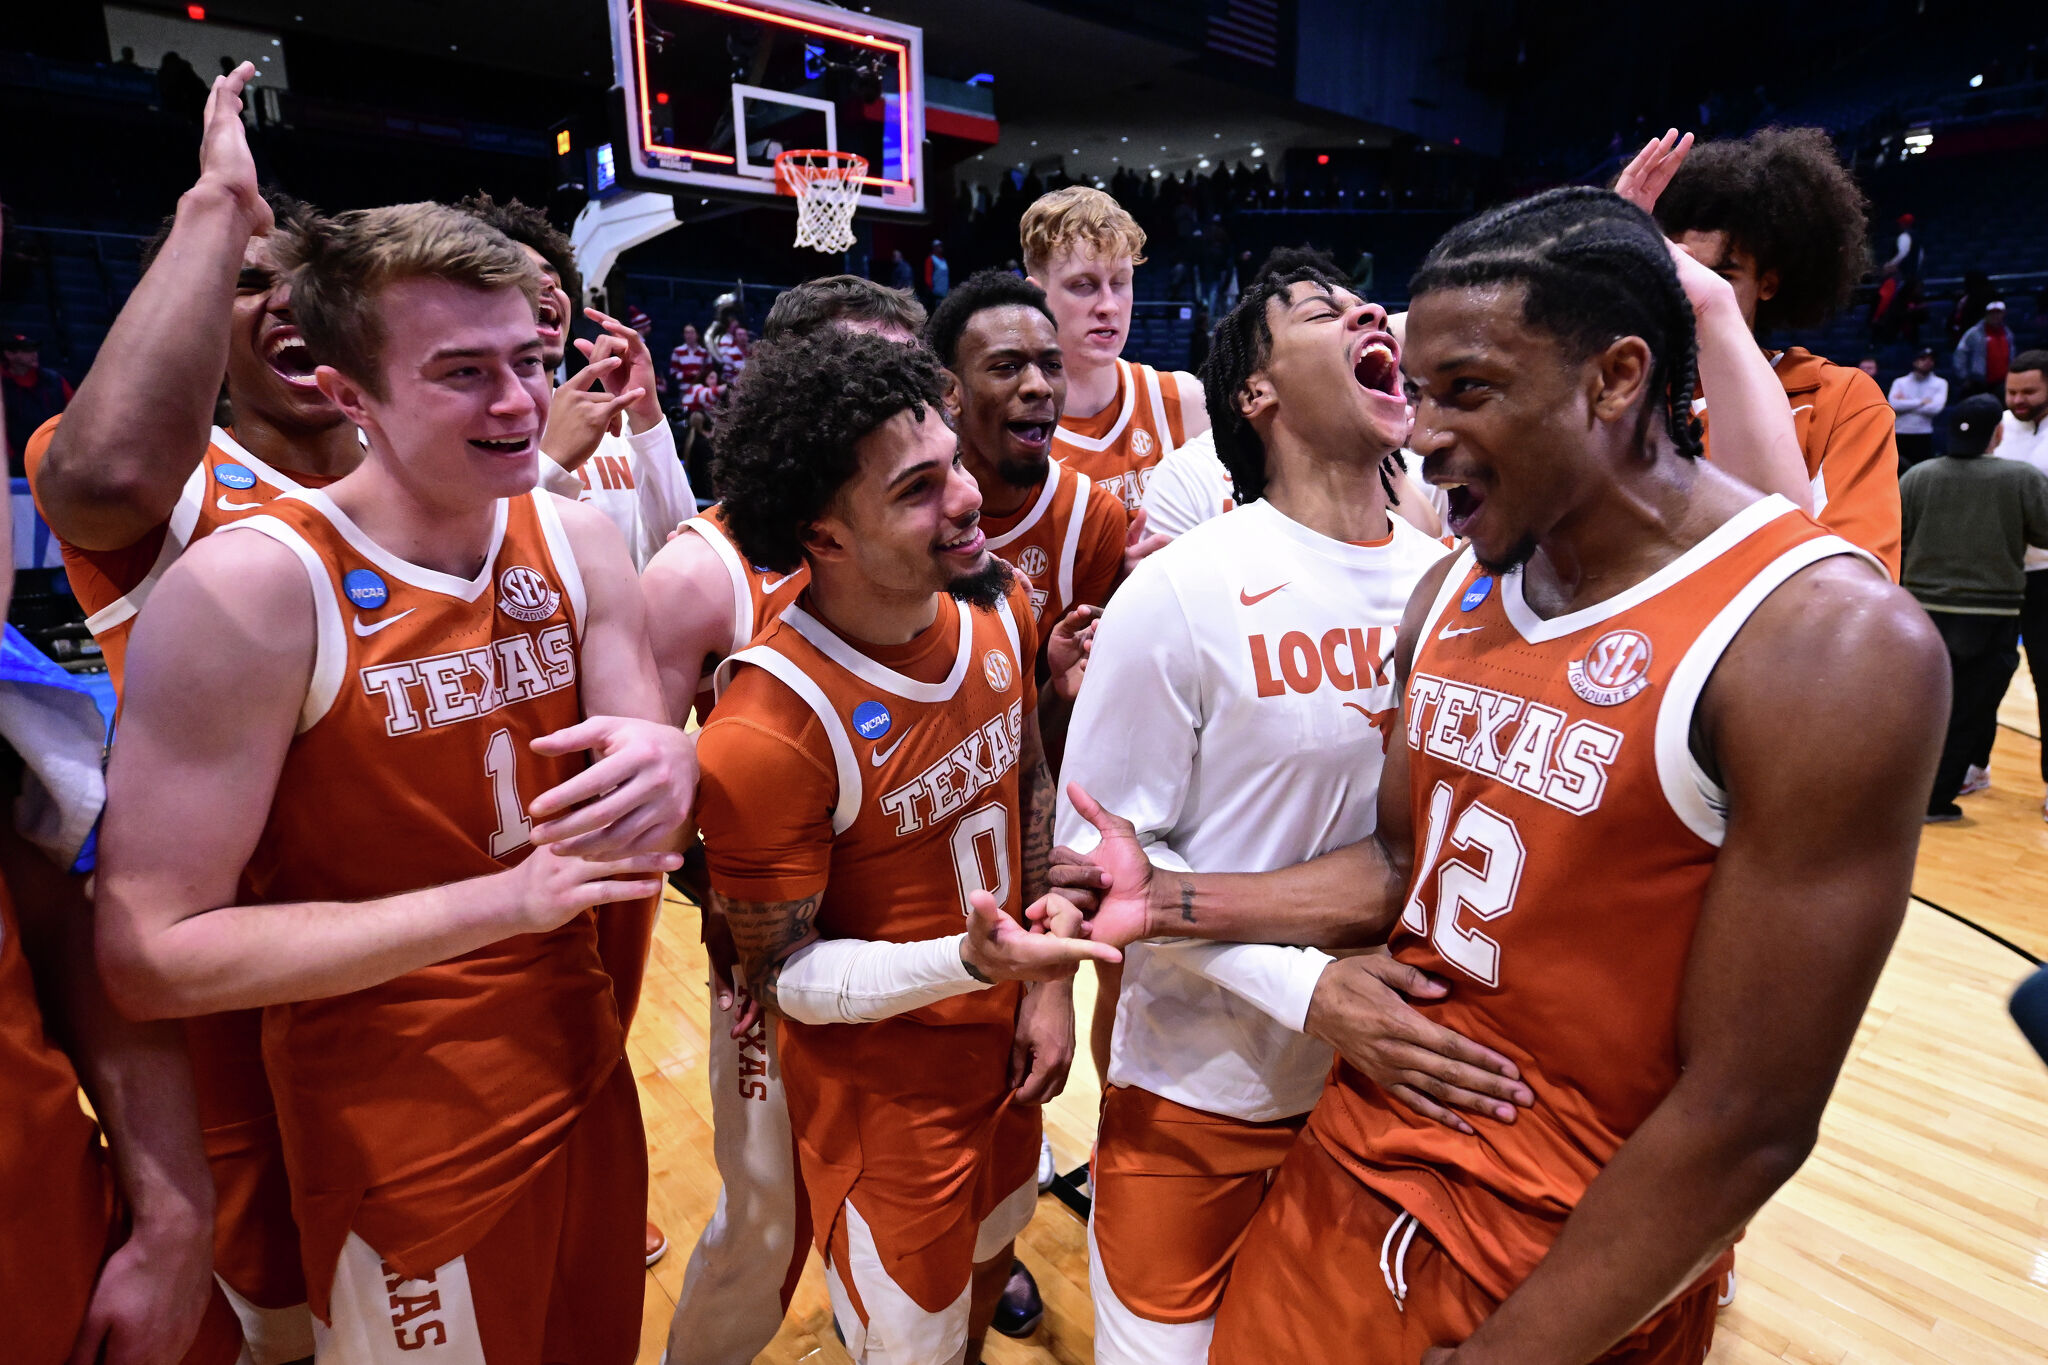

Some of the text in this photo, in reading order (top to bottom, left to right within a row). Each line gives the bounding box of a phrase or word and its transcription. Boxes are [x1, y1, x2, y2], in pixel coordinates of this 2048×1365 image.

[219, 473, 253, 484] NCAA
[1021, 548, 1046, 575] SEC
[351, 587, 386, 598] NCAA
[504, 569, 547, 607] SEC
[508, 600, 557, 621] GRADUATE
[986, 653, 1011, 689] SEC
[1589, 634, 1648, 686] SEC
[359, 624, 577, 737] TEXAS
[1571, 672, 1631, 705] GRADUATE
[860, 712, 890, 734] NCAA
[1407, 671, 1625, 817] TEXAS
[879, 697, 1022, 836] TEXAS
[484, 728, 533, 859] 1
[950, 801, 1011, 918] 0
[1400, 780, 1526, 988] 12
